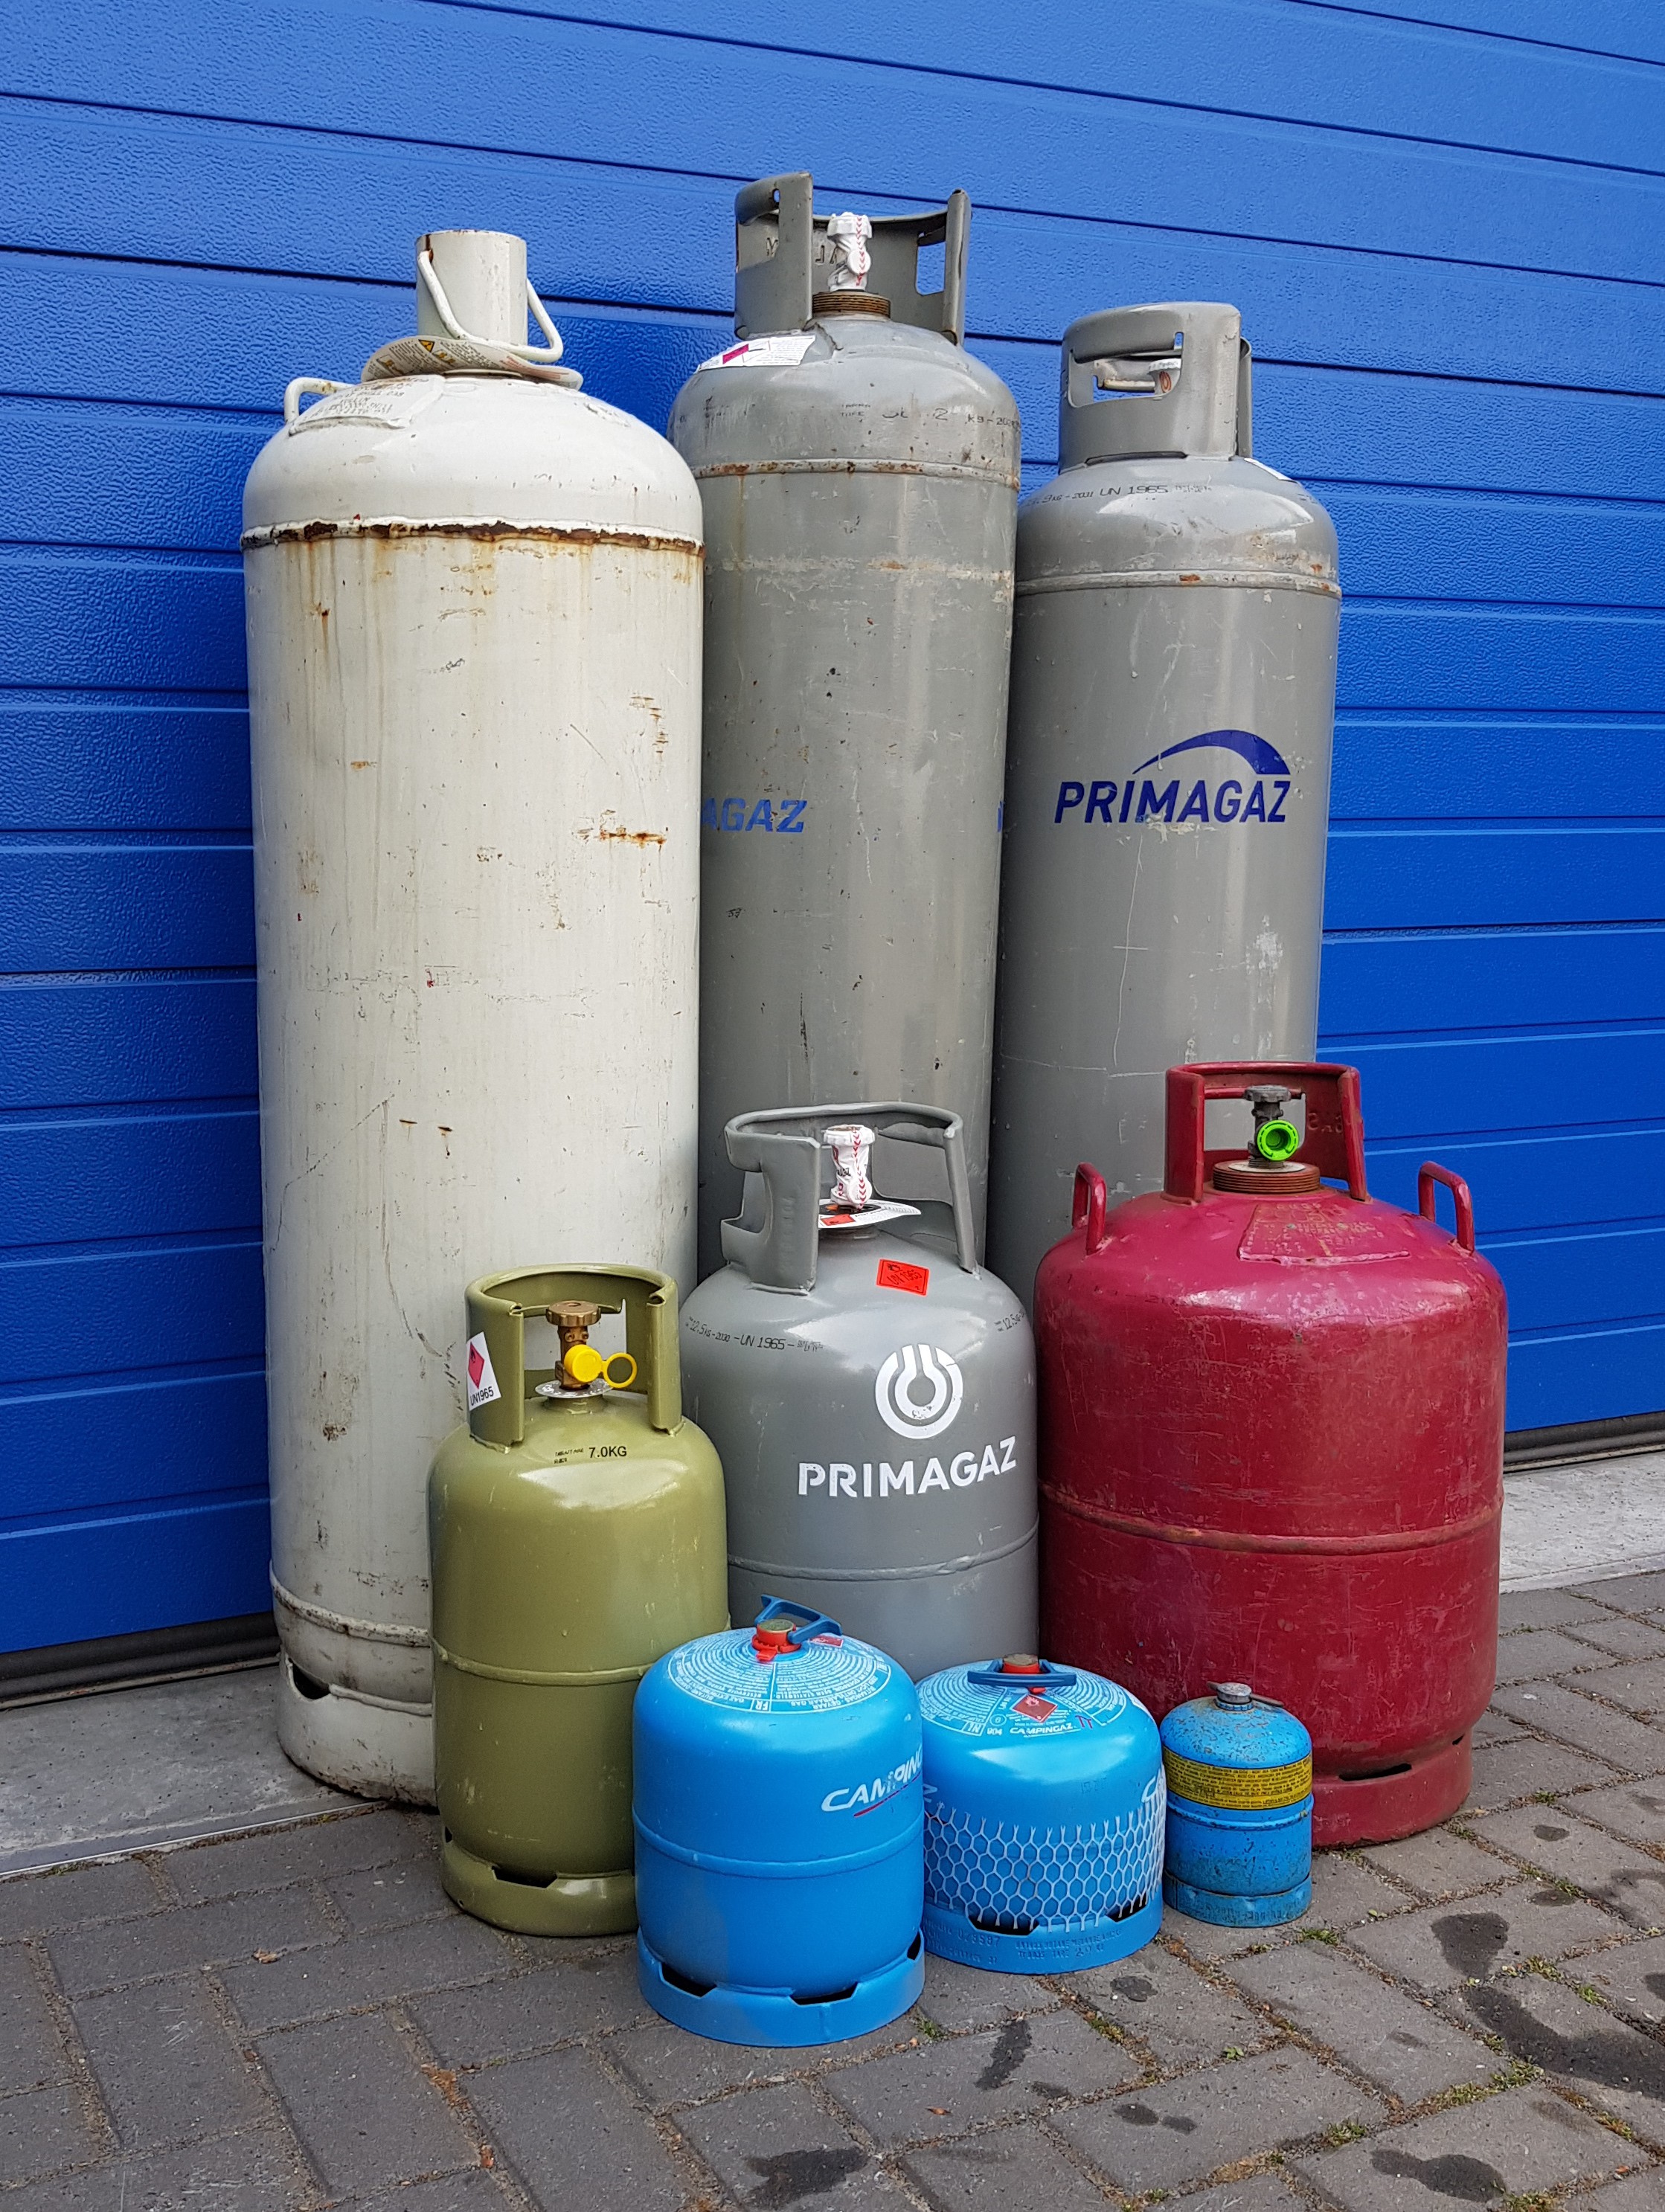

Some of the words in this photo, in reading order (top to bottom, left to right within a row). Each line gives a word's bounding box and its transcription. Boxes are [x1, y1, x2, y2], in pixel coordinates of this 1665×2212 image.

[1100, 486, 1122, 497] UN
[1126, 484, 1170, 495] 1965
[1054, 779, 1291, 823] PRIMAGAZ
[588, 1445, 627, 1459] 7.0KG
[798, 1436, 1017, 1497] PRIMAGAZ
[755, 1700, 769, 1711] FR
[1009, 1722, 1074, 1734] CAMPINGAZ
